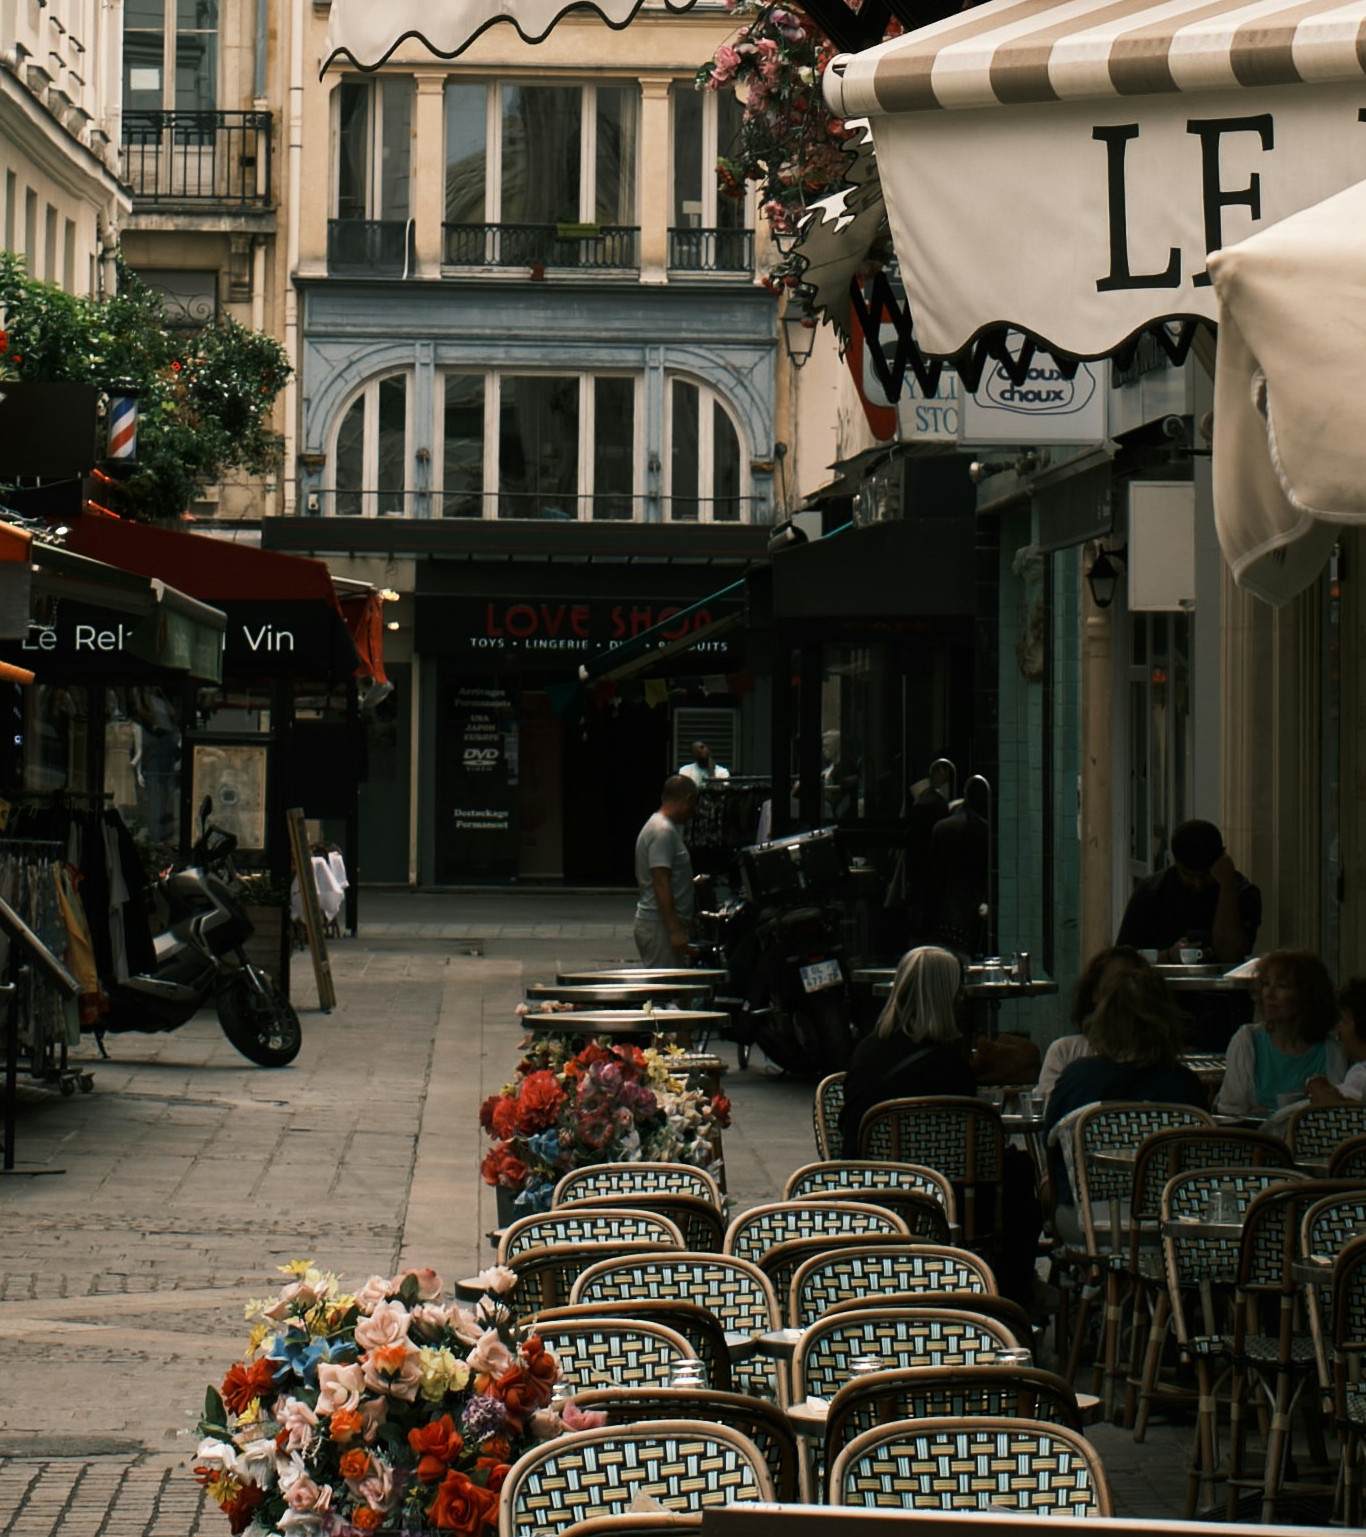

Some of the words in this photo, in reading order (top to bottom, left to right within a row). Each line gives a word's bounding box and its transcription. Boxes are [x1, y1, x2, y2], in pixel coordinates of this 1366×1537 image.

[1092, 113, 1274, 293] LE
[1000, 384, 1065, 402] choux
[486, 604, 590, 638] LOVE
[612, 605, 713, 641] SHOP
[75, 624, 133, 652] Rel
[242, 624, 296, 652] Vin
[470, 638, 505, 649] TOYS
[525, 639, 589, 651] LINGERIE
[463, 748, 500, 760] DVD
